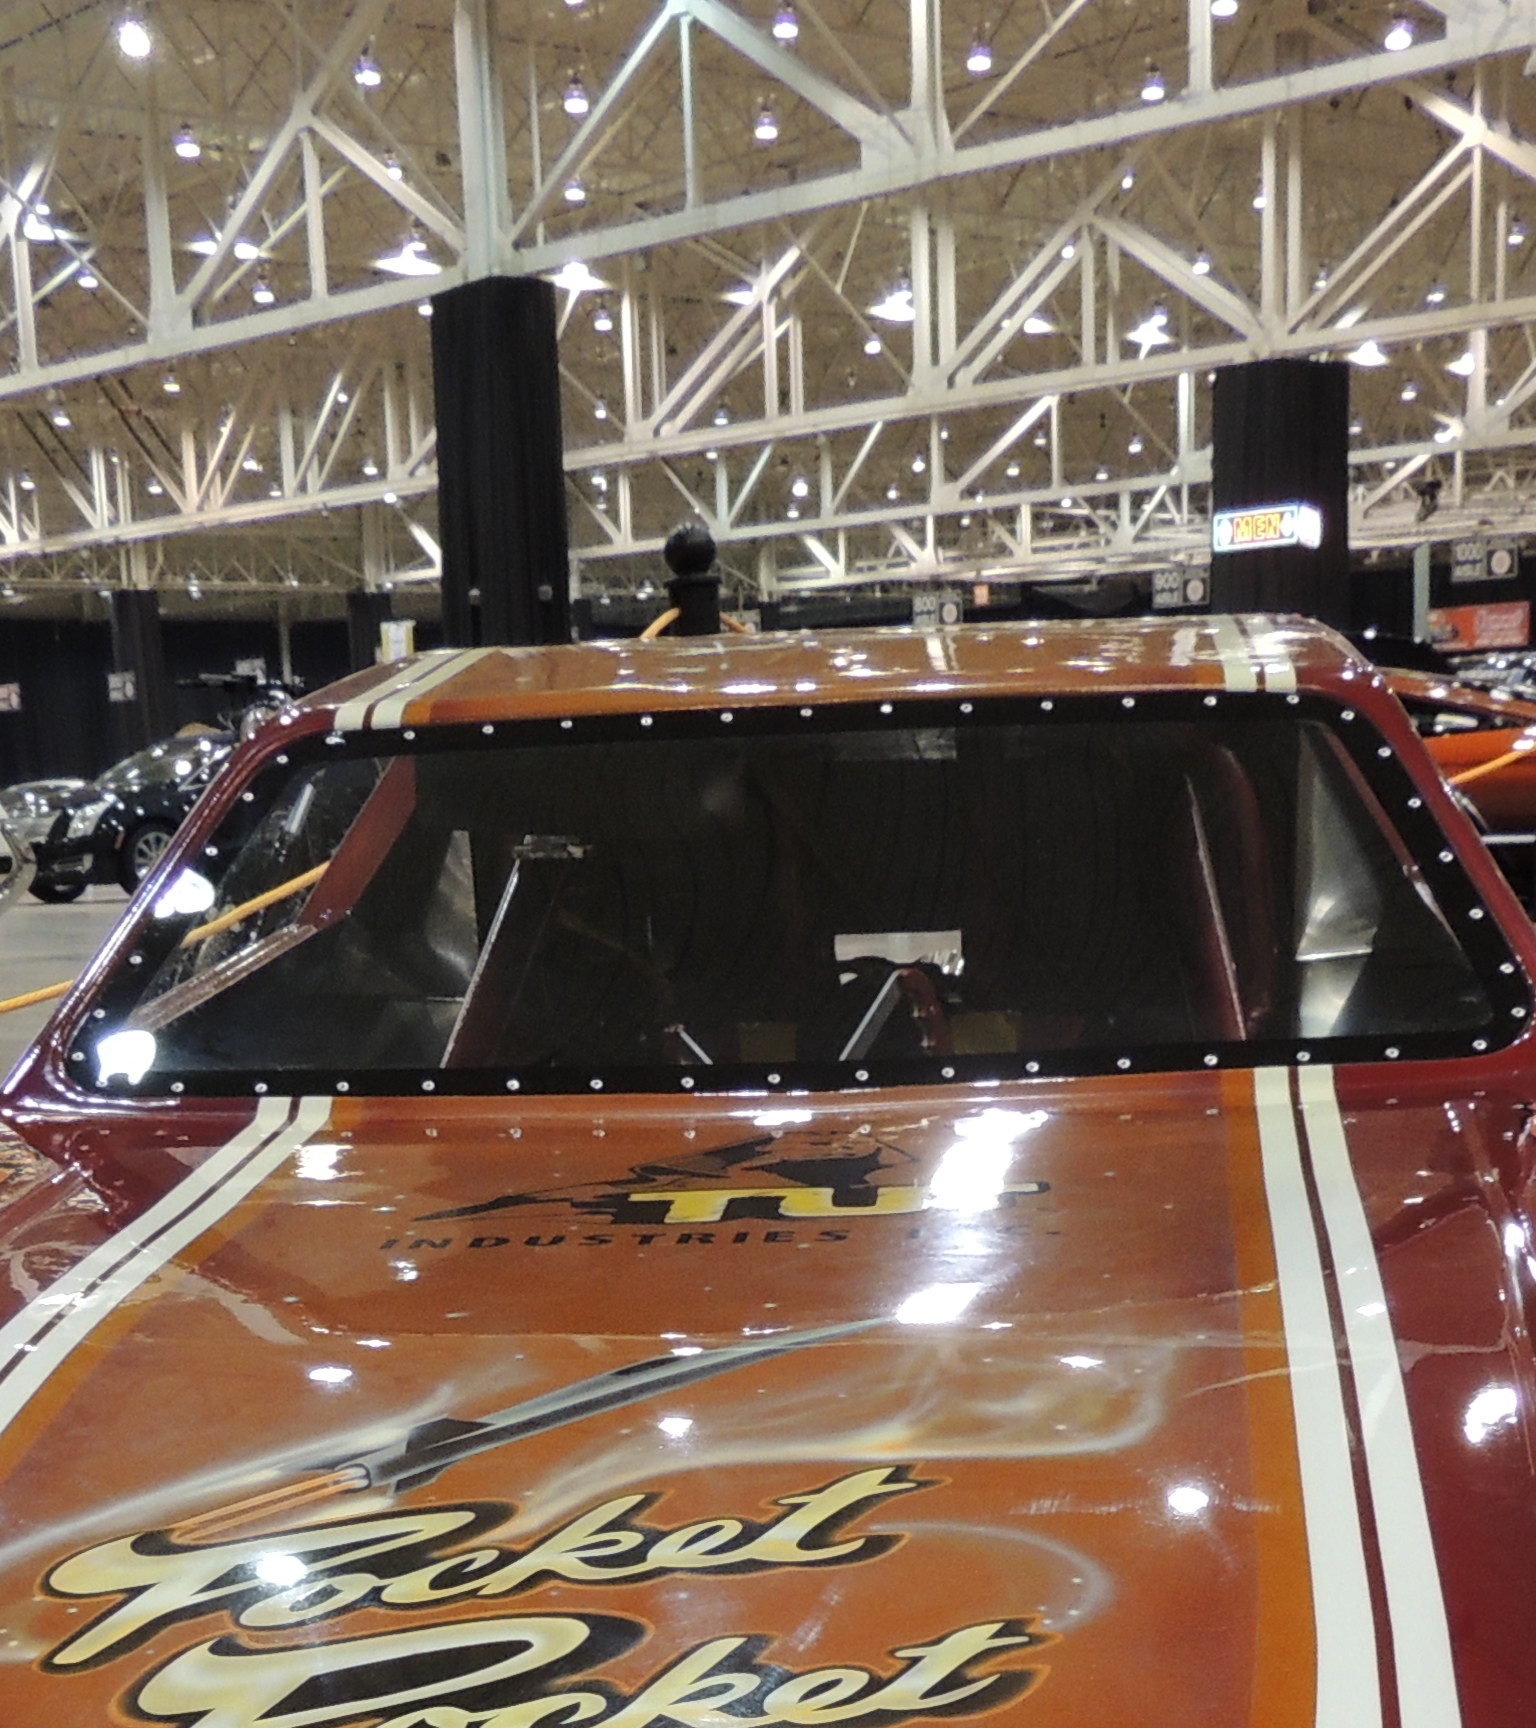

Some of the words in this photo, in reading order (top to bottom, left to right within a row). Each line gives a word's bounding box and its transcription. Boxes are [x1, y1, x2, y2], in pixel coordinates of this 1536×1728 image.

[1232, 513, 1281, 544] MEN
[377, 1229, 852, 1251] INDUSTRIES
[42, 1464, 932, 1669] Pocket
